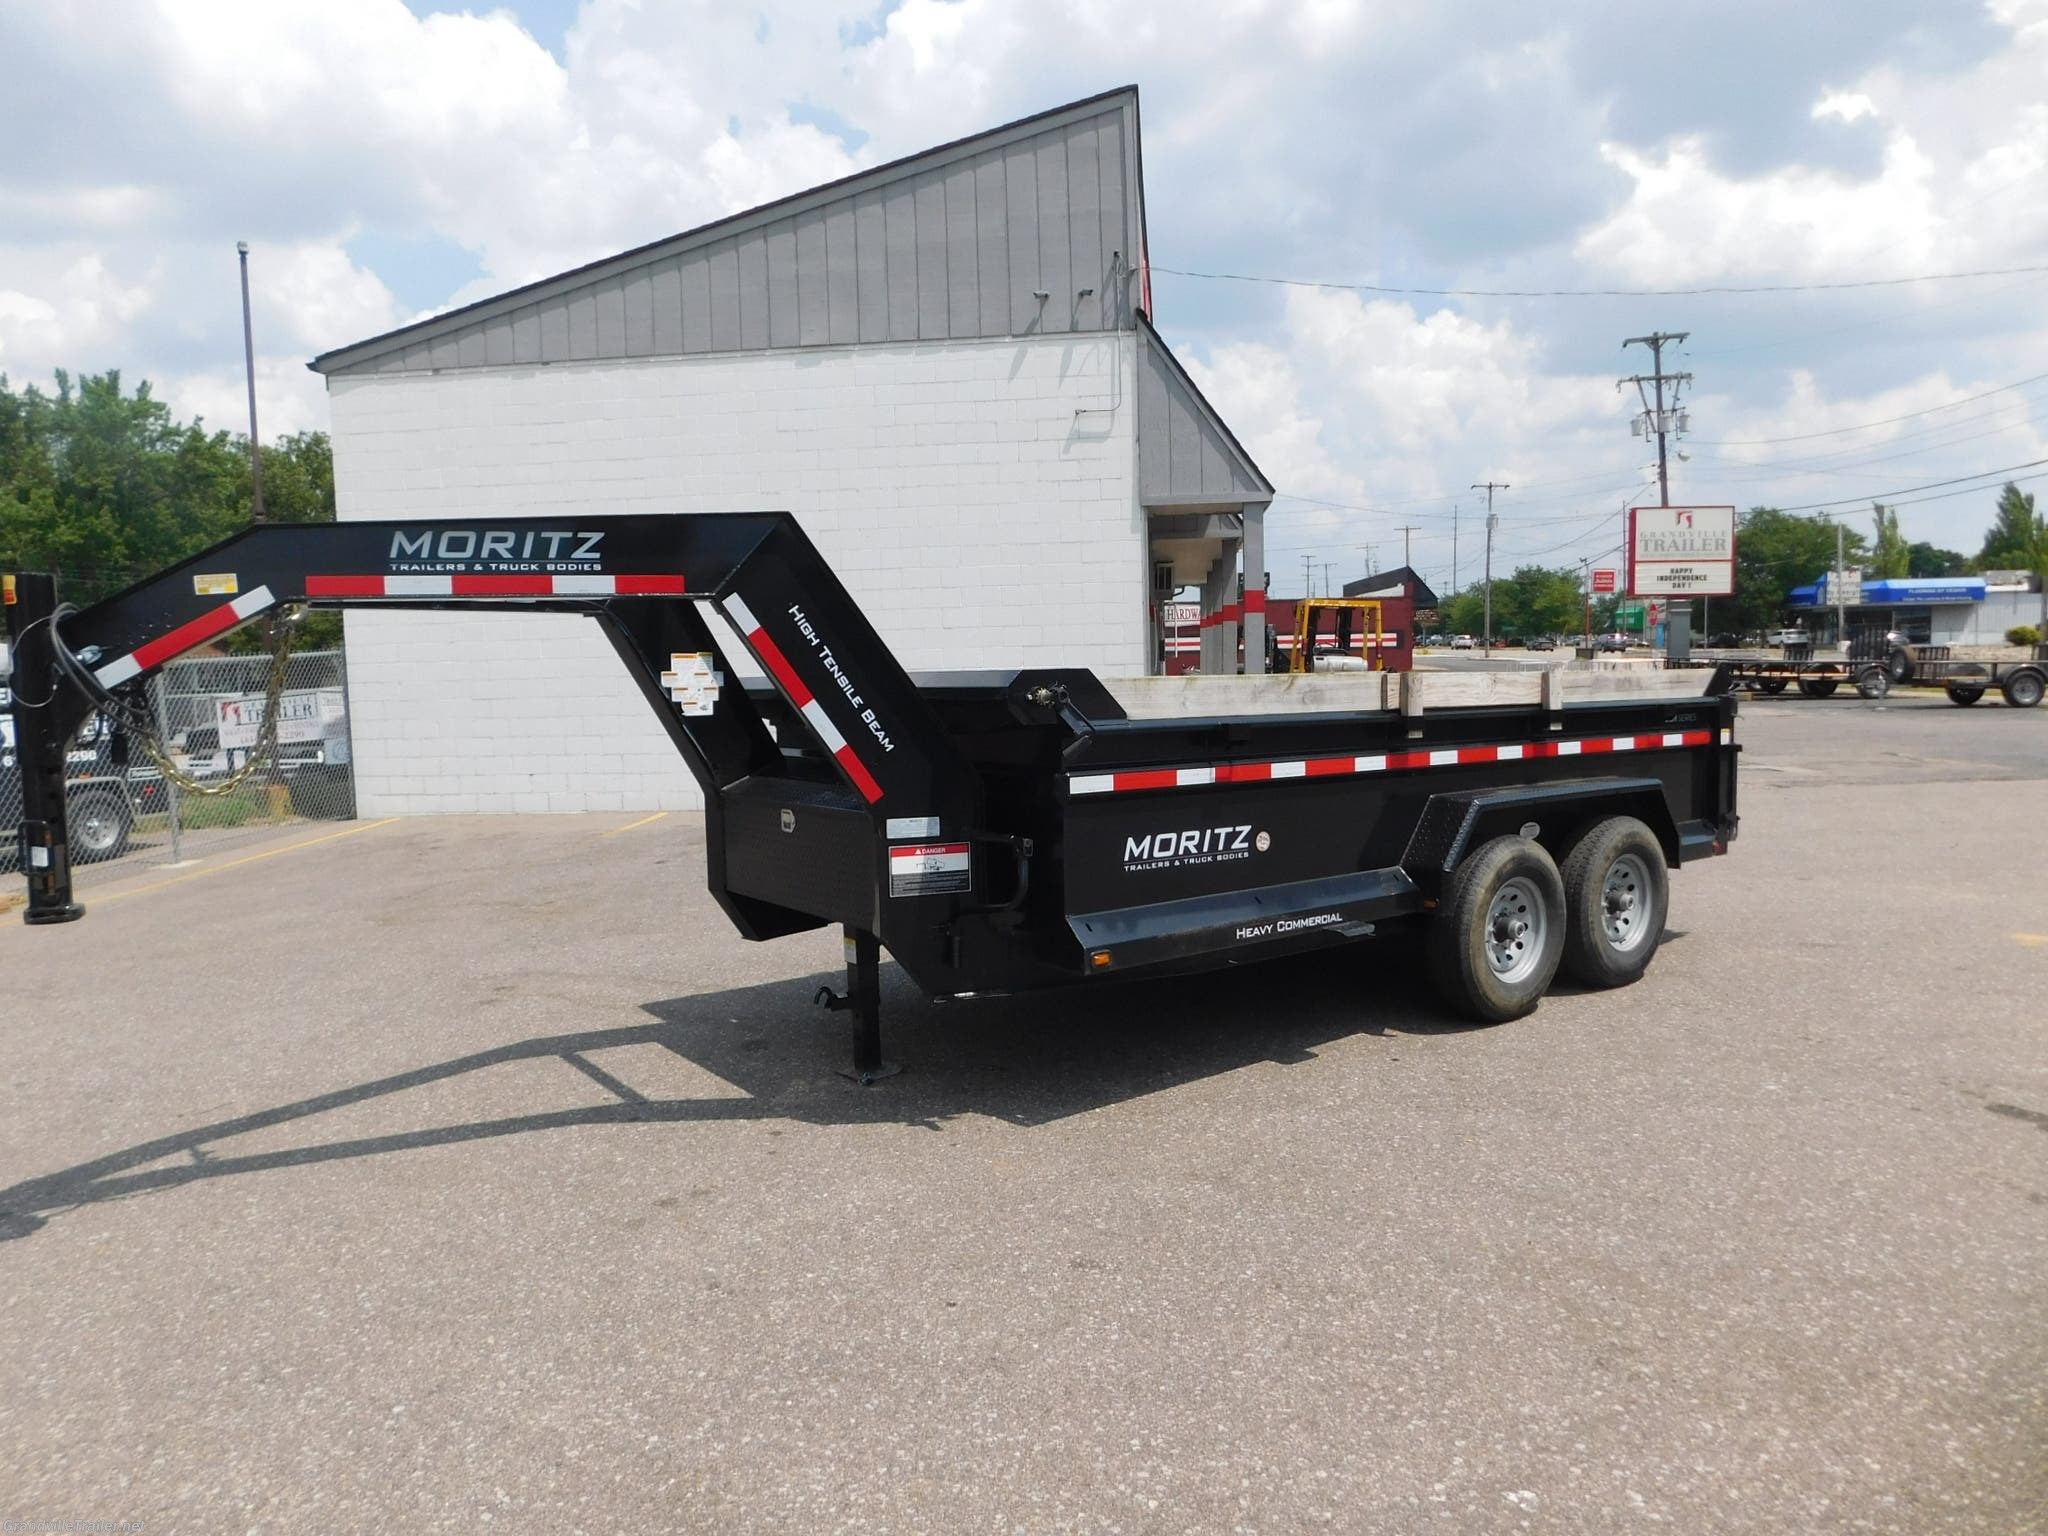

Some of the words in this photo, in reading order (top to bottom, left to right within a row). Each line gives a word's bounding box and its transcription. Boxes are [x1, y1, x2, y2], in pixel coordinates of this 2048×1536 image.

[1640, 530, 1727, 538] GRANDVILLE
[389, 530, 605, 559] MORITZ
[1640, 538, 1727, 552] TRAILER
[390, 563, 466, 571] TRAILERS
[473, 563, 484, 571] &
[489, 563, 540, 571] TRUCK
[546, 563, 602, 571] BODIES
[788, 604, 820, 646] HIGH
[818, 645, 864, 708] TENSILE
[861, 708, 895, 753] BEAM
[247, 704, 312, 722] TRILER
[922, 847, 946, 855] DANGER
[1124, 824, 1252, 862] MORITZ
[1124, 861, 1170, 872] TRAILERS
[1174, 859, 1181, 867] &
[1184, 856, 1213, 865] TRUCK
[1217, 852, 1249, 861] BODIES
[1236, 924, 1274, 939] HEAVY
[1277, 912, 1343, 932] COMMERCIAL
